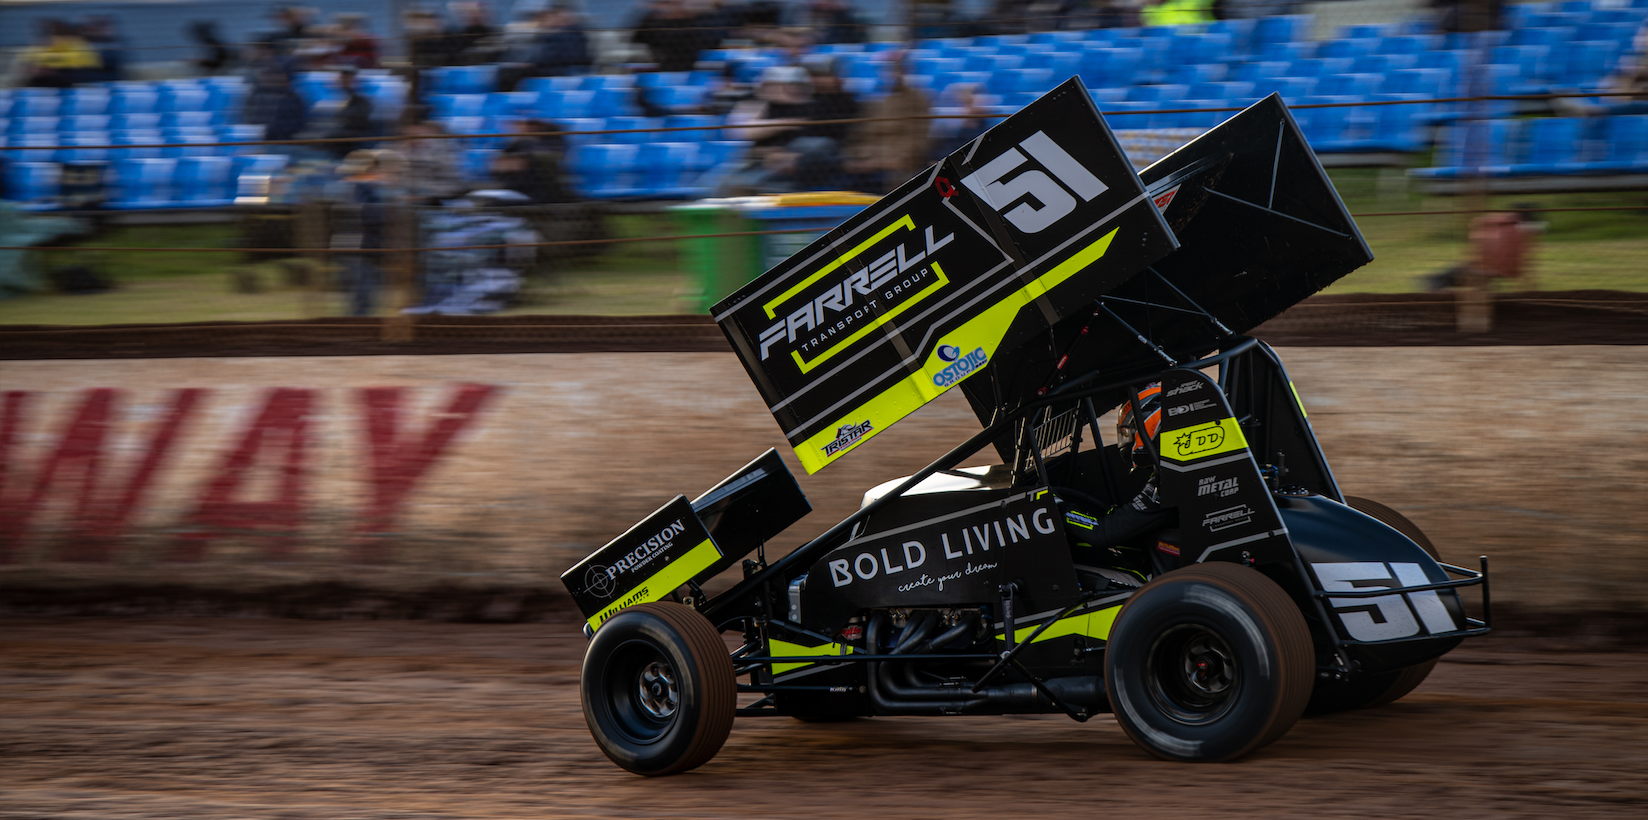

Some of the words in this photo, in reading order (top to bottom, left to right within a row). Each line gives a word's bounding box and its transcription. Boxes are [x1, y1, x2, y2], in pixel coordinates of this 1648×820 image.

[960, 130, 1109, 233] 51
[759, 225, 955, 361] FARRELL
[802, 300, 878, 351] TRANSPORT
[885, 268, 928, 300] GROUP
[933, 346, 986, 386] OSTOJIC
[820, 419, 873, 455] TRISTAR
[1197, 477, 1239, 496] METAL
[1198, 476, 1216, 486] RAW
[1221, 487, 1239, 497] CORP
[1202, 508, 1255, 526] FARRELL
[605, 519, 685, 580] PRECISION
[631, 555, 653, 573] POWDER
[652, 542, 673, 559] COATING
[828, 540, 926, 587] BOLD
[941, 508, 1055, 560] LIVING
[898, 574, 935, 592] create
[938, 571, 962, 591] your
[965, 562, 997, 575] dream
[1311, 562, 1458, 641] 51
